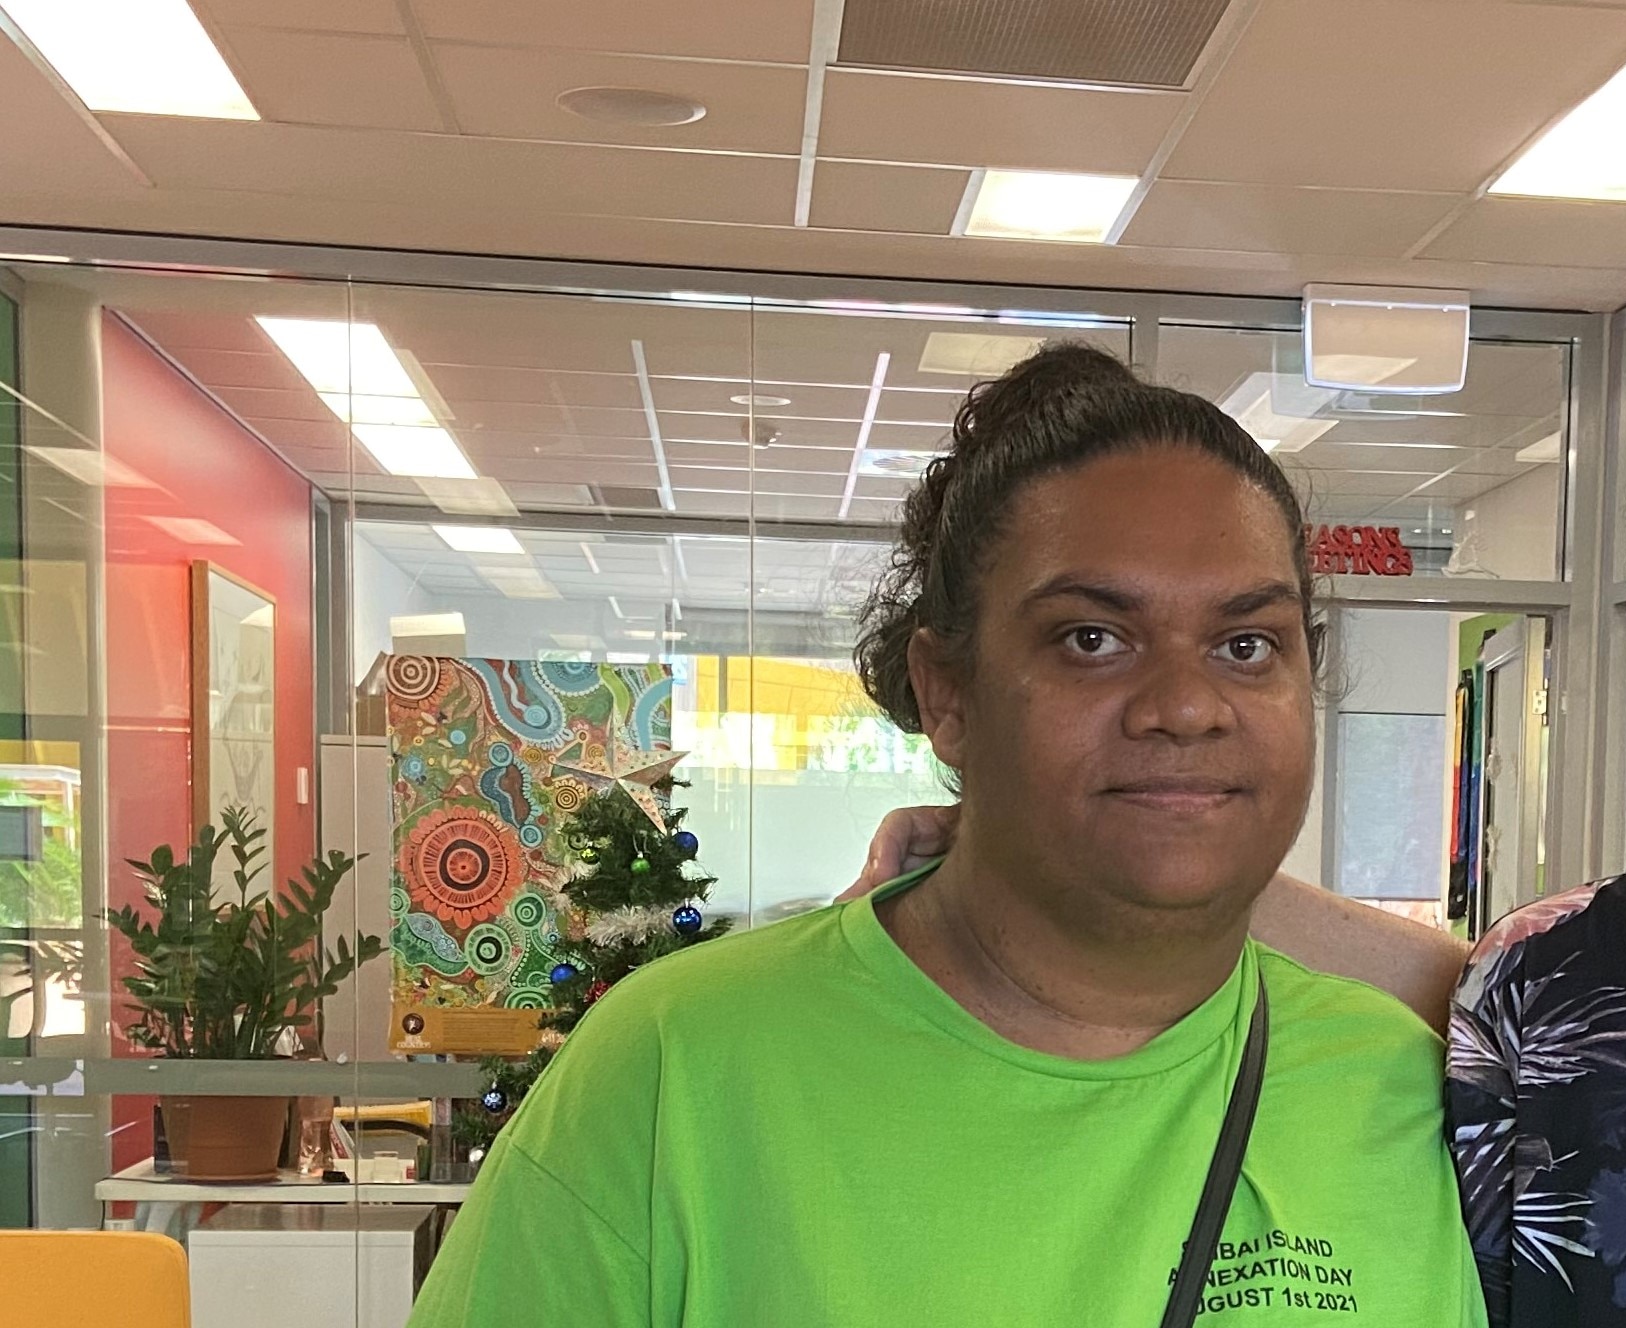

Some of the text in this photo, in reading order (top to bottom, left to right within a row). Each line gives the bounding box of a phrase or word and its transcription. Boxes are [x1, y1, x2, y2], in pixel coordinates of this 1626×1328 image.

[1304, 524, 1402, 551] ASONS
[1309, 547, 1413, 576] ETINGS
[1266, 1229, 1333, 1258] ISLAND
[1168, 1257, 1352, 1288] ANEXATION DAY
[1196, 1286, 1358, 1315] UGUST 1st 2021
